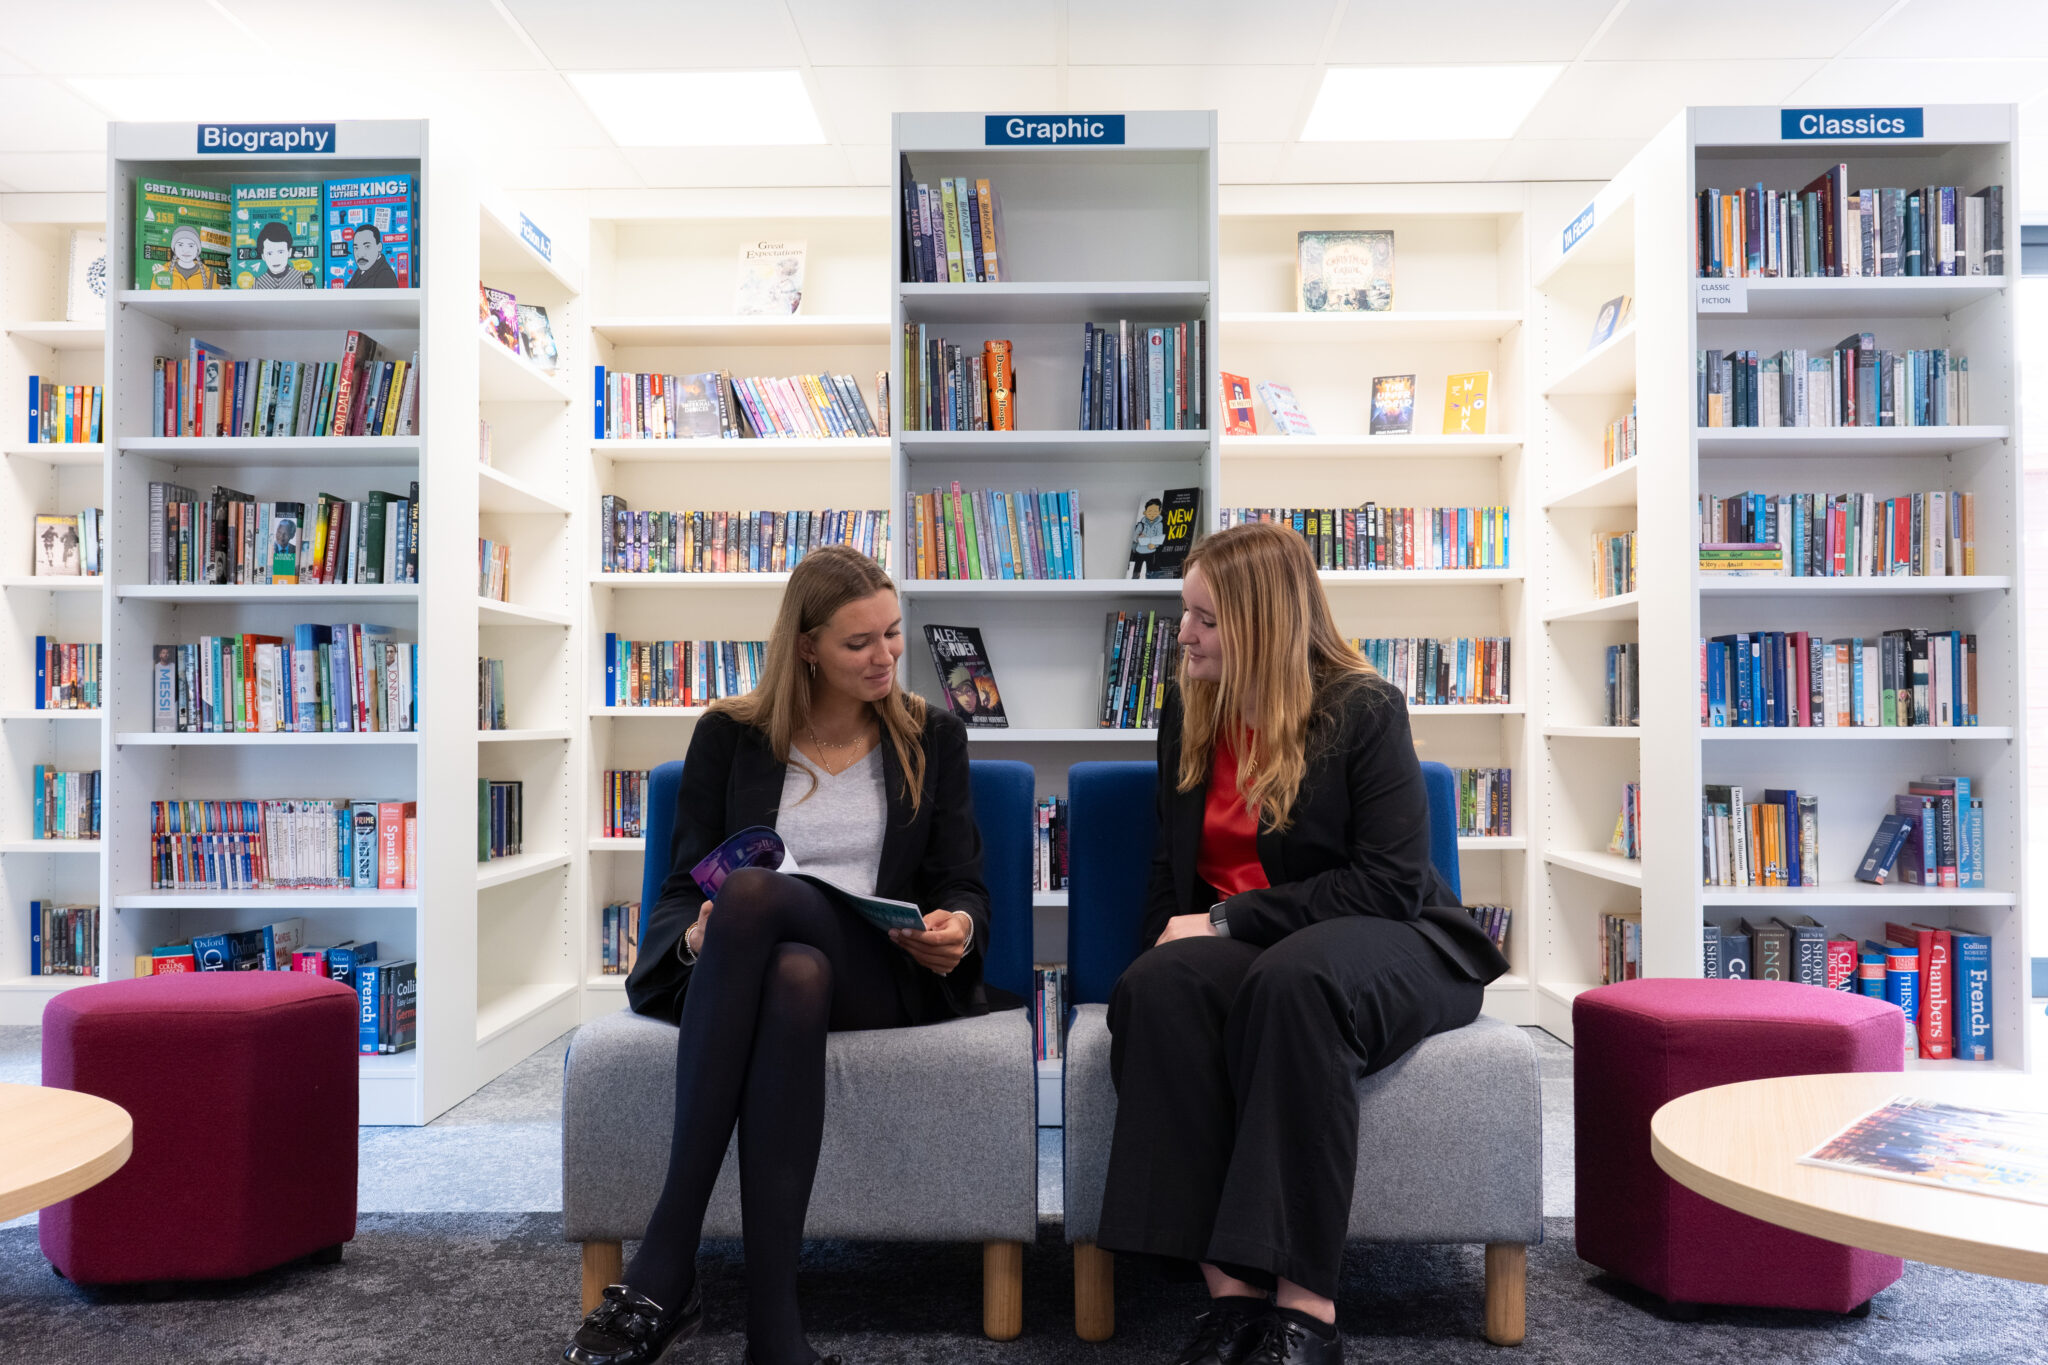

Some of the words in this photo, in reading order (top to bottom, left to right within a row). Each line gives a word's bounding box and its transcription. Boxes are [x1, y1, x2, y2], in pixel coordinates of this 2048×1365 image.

[1005, 118, 1105, 143] Graphic
[1799, 114, 1906, 136] Classics
[203, 127, 329, 151] Biography
[144, 183, 178, 196] GRETA
[236, 188, 277, 199] MARIE
[280, 186, 318, 198] CURIE
[330, 184, 358, 192] MARTIN
[330, 190, 358, 198] LUTHER
[360, 180, 398, 196] KING
[912, 209, 920, 237] MAUS
[746, 249, 803, 259] Expectations
[757, 241, 785, 250] Great
[304, 364, 313, 394] ALASTAIR
[994, 354, 1005, 388] Dragon
[338, 378, 352, 413] DALEY
[1375, 399, 1412, 409] WORLD
[996, 400, 1006, 426] Hoops
[334, 414, 346, 437] TOM
[150, 484, 162, 510] JORDAN
[330, 504, 338, 527] LIONESS
[1166, 508, 1194, 526] NEW
[1321, 514, 1332, 536] GONE
[1356, 514, 1366, 536] LIGHT
[150, 512, 162, 553] HENDERSON
[326, 550, 334, 572] MEAD
[933, 628, 960, 642] ALEX
[950, 642, 978, 656] RIDER
[160, 668, 170, 711] MESSI
[388, 670, 398, 702] JONNY
[1942, 798, 1951, 852] SCIENTISTS
[384, 824, 398, 874] Spanish
[1972, 818, 1983, 873] PHILOSOPH
[194, 938, 224, 948] Oxford
[362, 972, 376, 1024] French
[1930, 944, 1948, 1038] Chambers
[1970, 969, 1990, 1036] French
